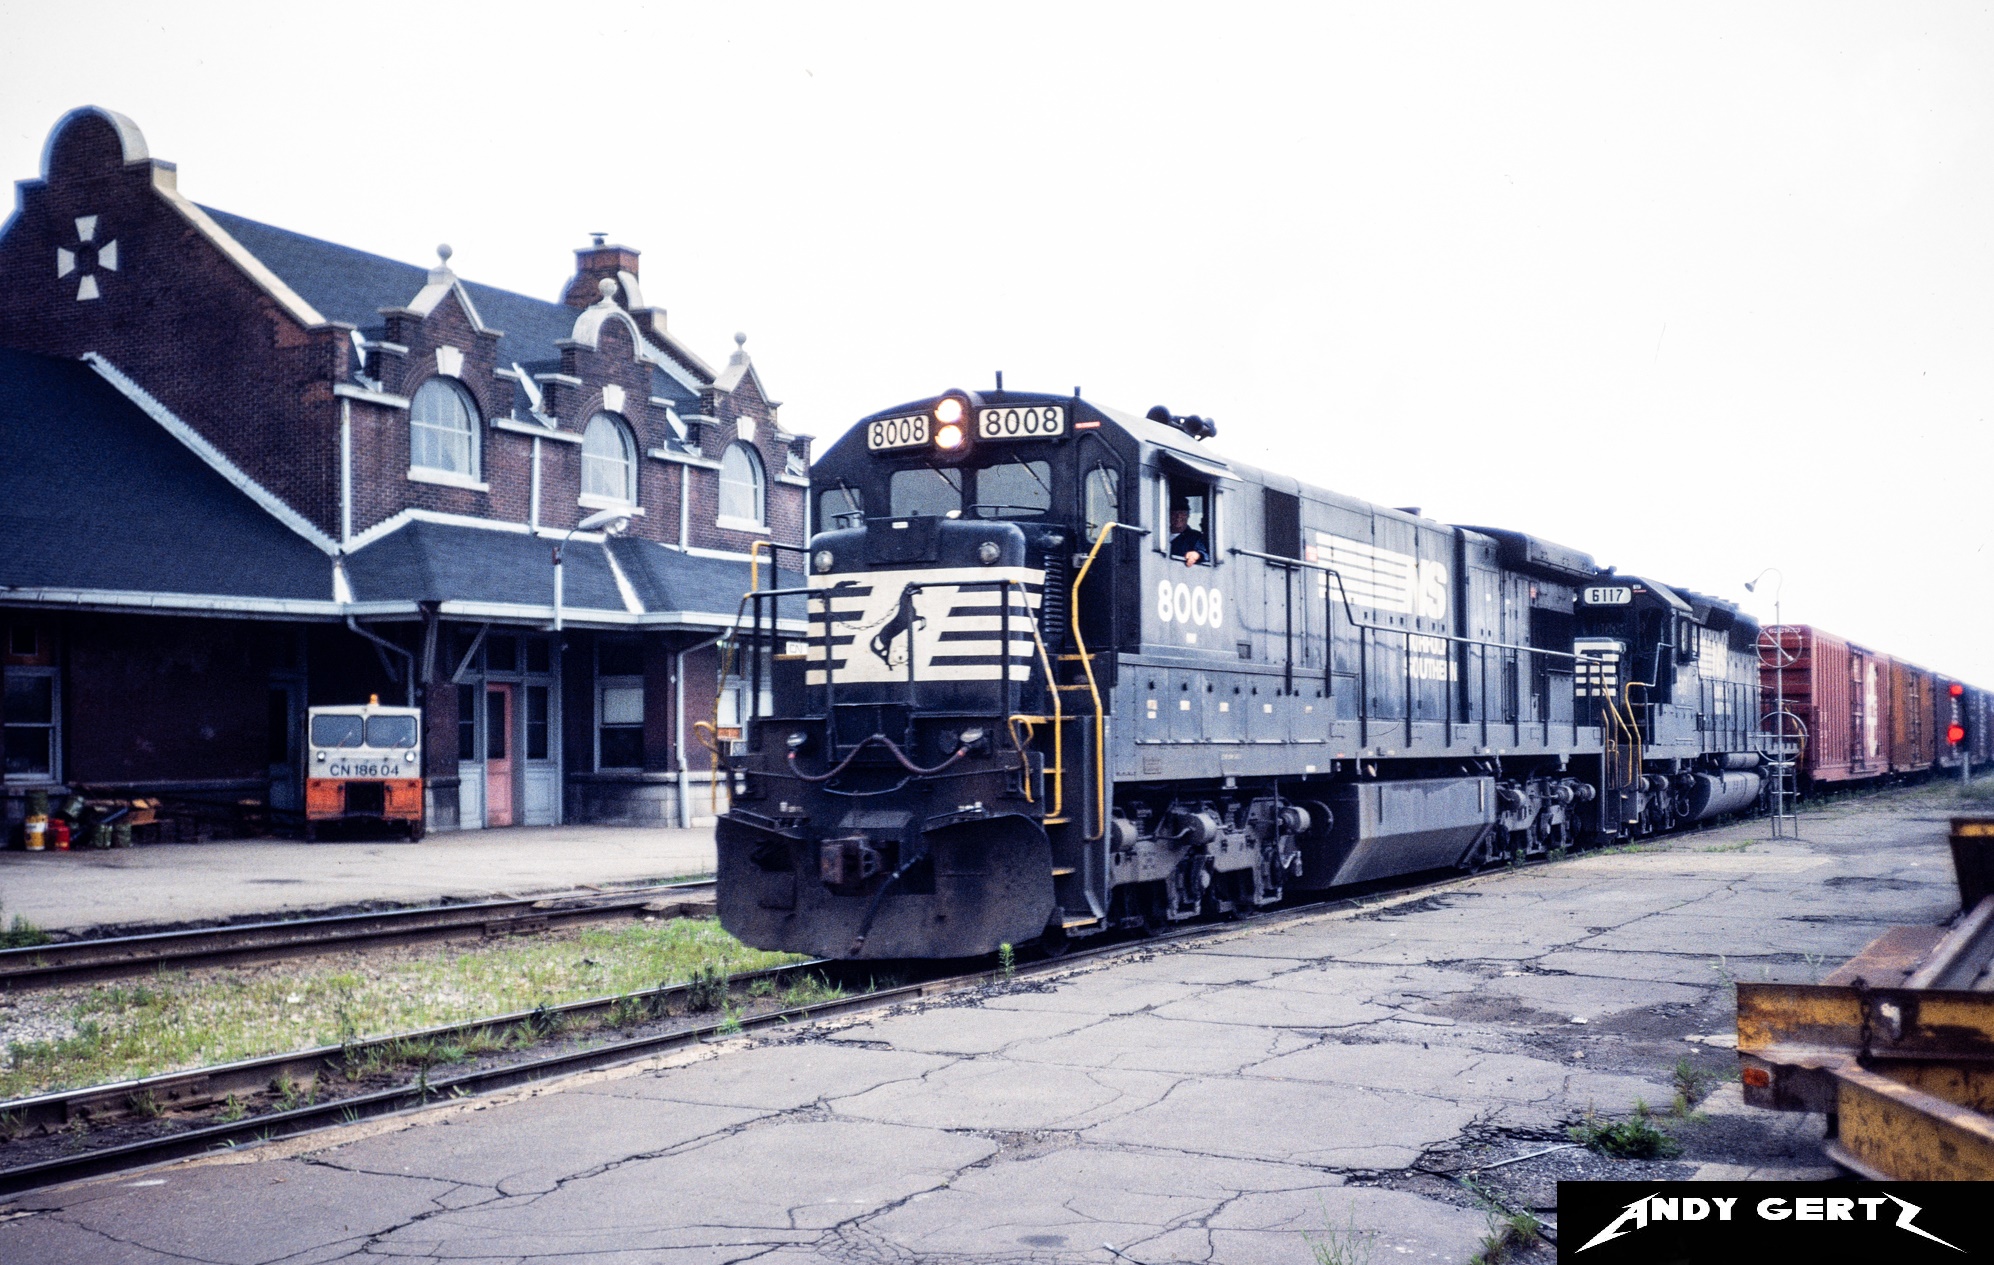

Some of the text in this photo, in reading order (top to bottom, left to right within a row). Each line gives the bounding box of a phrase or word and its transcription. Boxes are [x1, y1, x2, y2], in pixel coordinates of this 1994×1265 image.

[872, 416, 925, 447] 8008
[985, 406, 1058, 436] 8008
[1406, 555, 1449, 620] NS
[1592, 589, 1624, 602] 6117
[1158, 579, 1223, 629] 8008
[1403, 633, 1451, 656] NORFOL
[330, 764, 350, 776] CN
